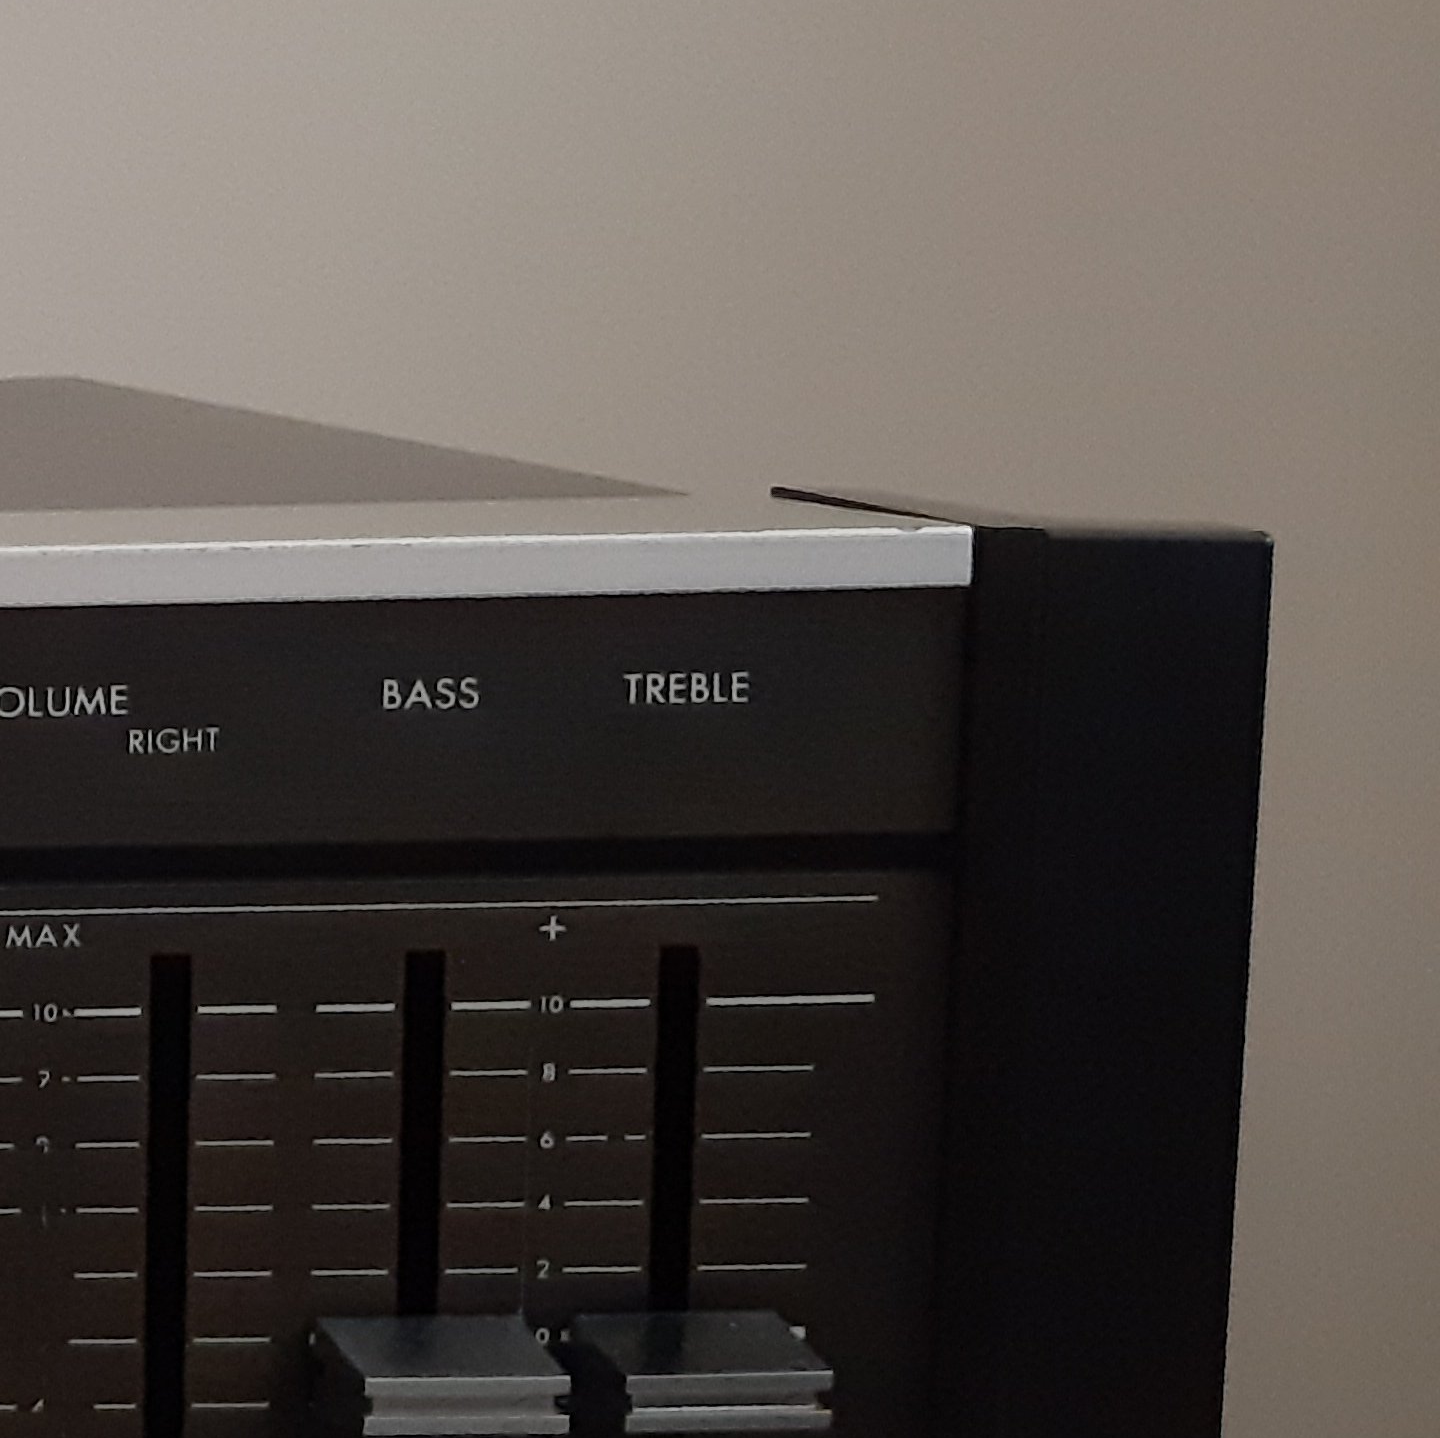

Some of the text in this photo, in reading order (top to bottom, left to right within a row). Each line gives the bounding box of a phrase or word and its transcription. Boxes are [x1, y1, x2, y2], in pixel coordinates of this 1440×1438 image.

[382, 676, 480, 710] BASS
[623, 671, 749, 705] TREBLE
[128, 727, 220, 754] RIGHT
[5, 923, 81, 949] MAX
[34, 1003, 58, 1023] 10
[541, 995, 564, 1014] 10
[539, 1131, 555, 1149] 6
[536, 1259, 550, 1279] 2
